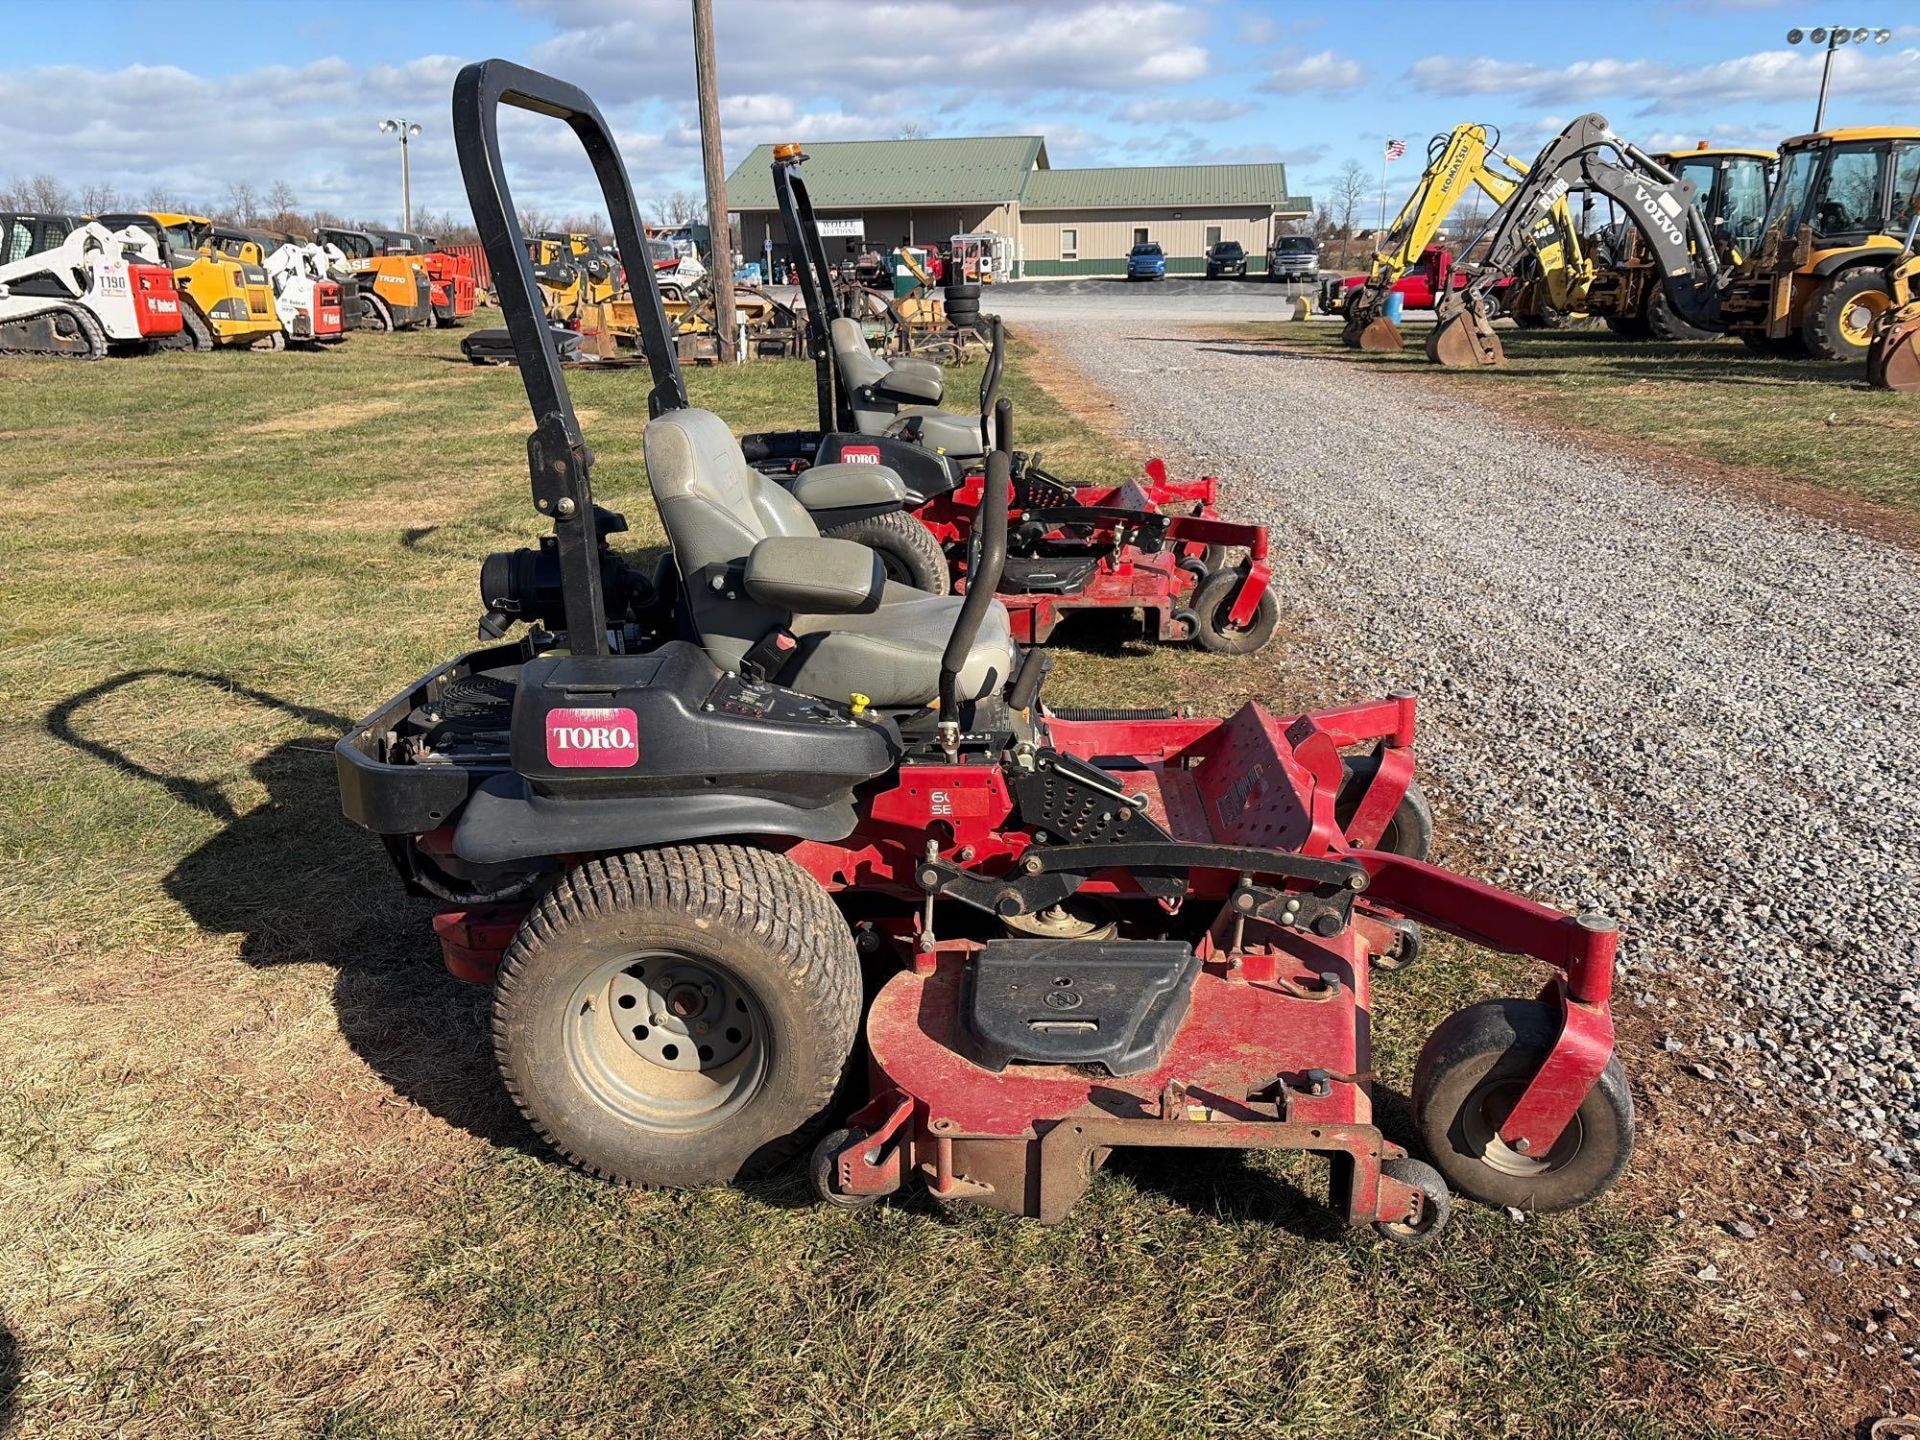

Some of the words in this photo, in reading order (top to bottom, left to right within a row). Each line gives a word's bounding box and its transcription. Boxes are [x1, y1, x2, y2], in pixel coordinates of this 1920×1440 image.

[1441, 145, 1469, 193] KOMATSU
[1538, 177, 1570, 211] BL70B
[1635, 184, 1683, 245] VOLVO
[99, 275, 126, 289] T190
[843, 454, 879, 464] TORO
